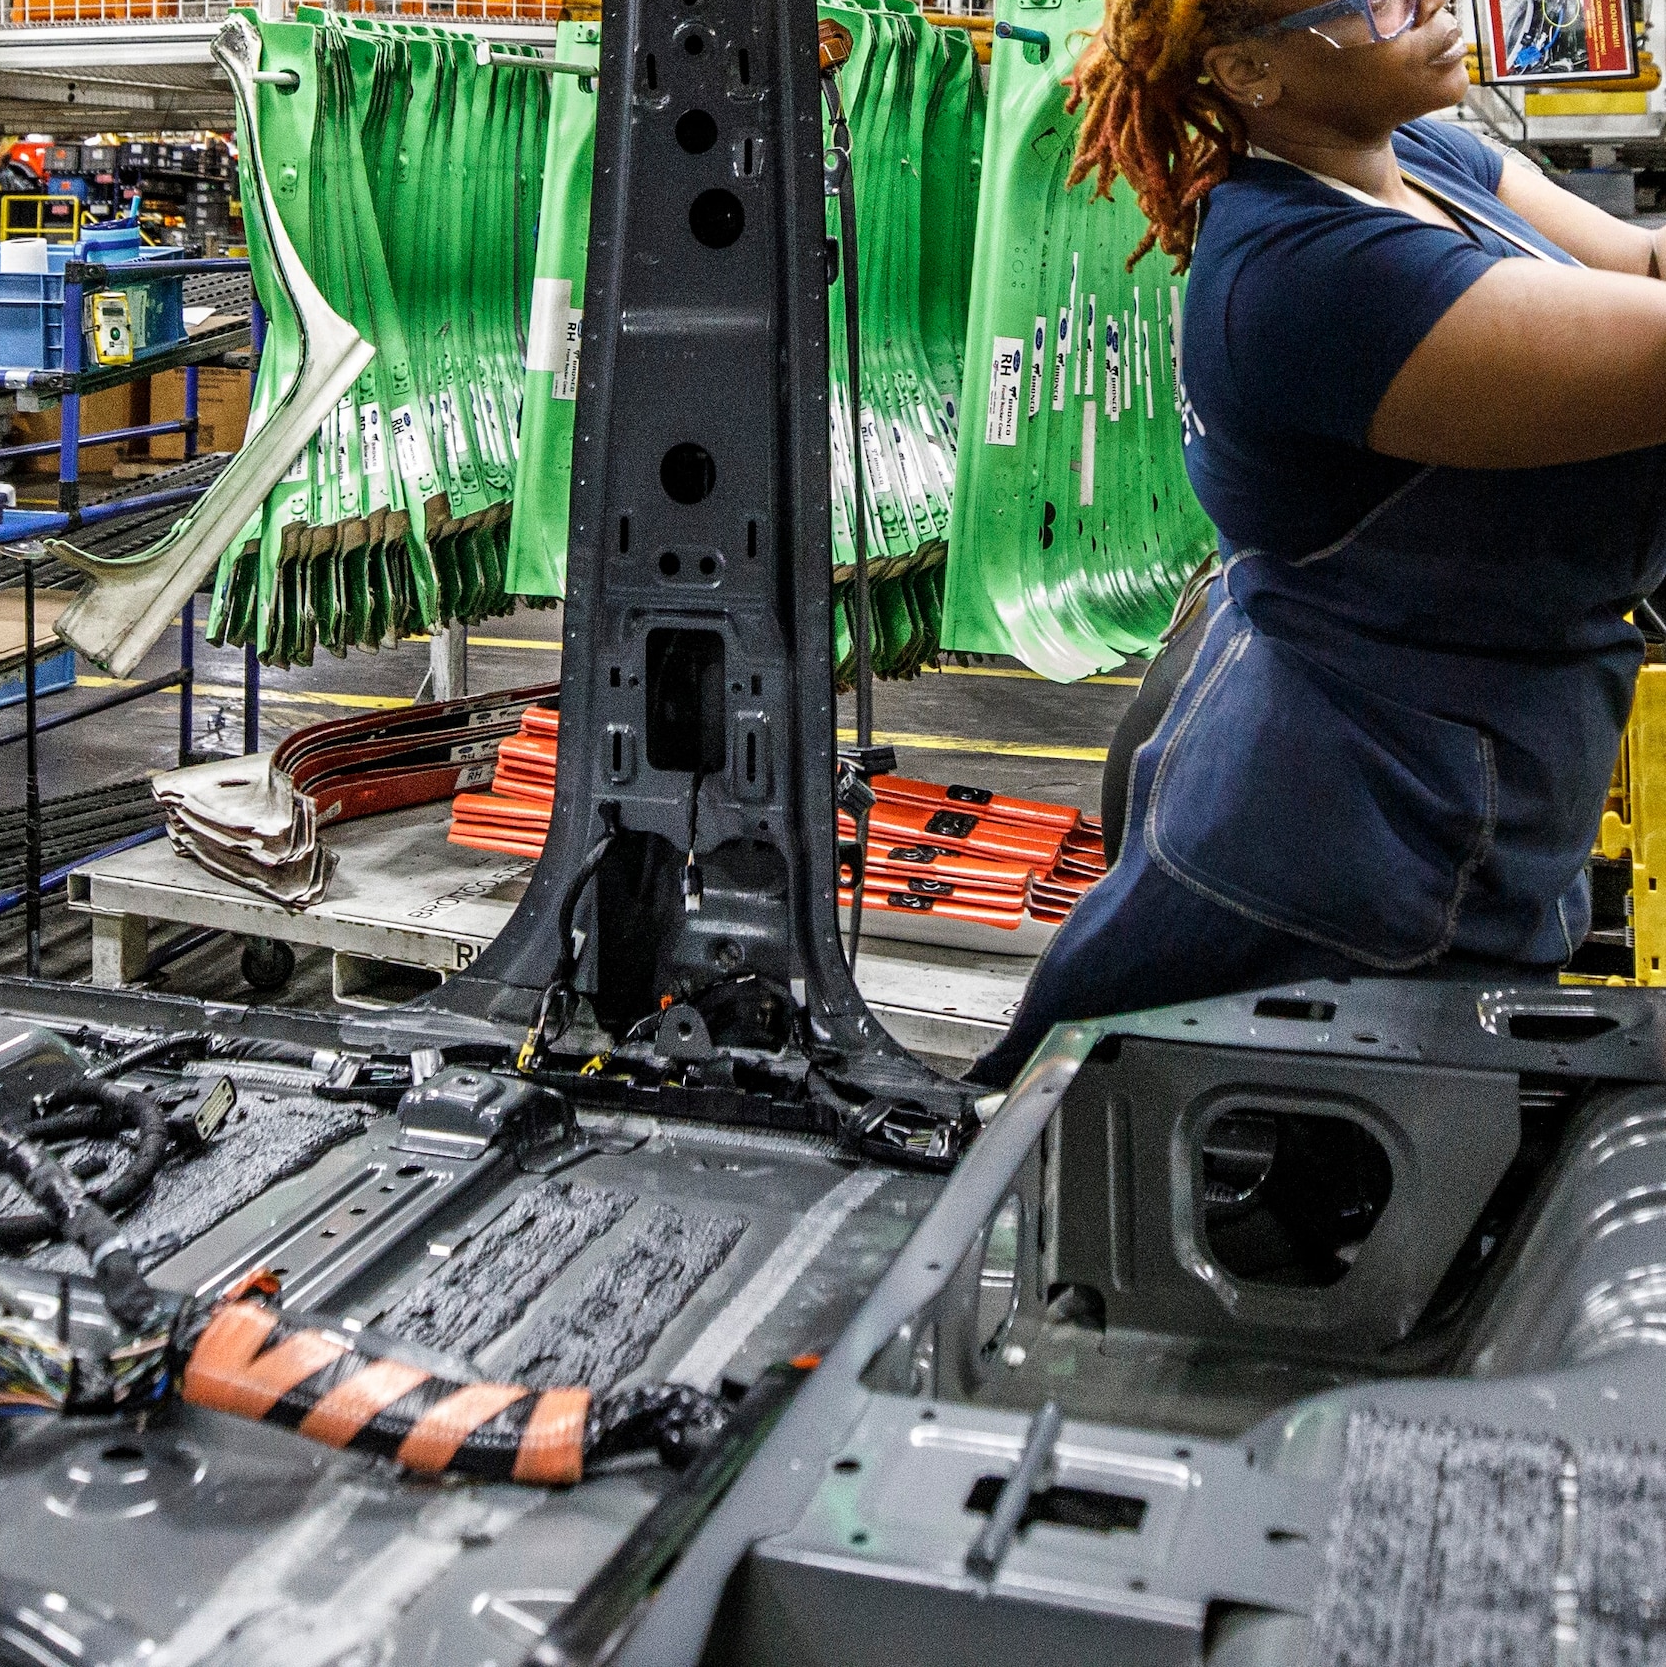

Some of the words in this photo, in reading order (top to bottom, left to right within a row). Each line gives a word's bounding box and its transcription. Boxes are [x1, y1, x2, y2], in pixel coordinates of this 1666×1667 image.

[1610, 3, 1621, 48] ROUTING!!!
[567, 322, 577, 342] RH
[1000, 354, 1012, 376] RH
[392, 418, 404, 435] RH
[467, 770, 482, 781] RH
[408, 880, 499, 918] BRONCO
